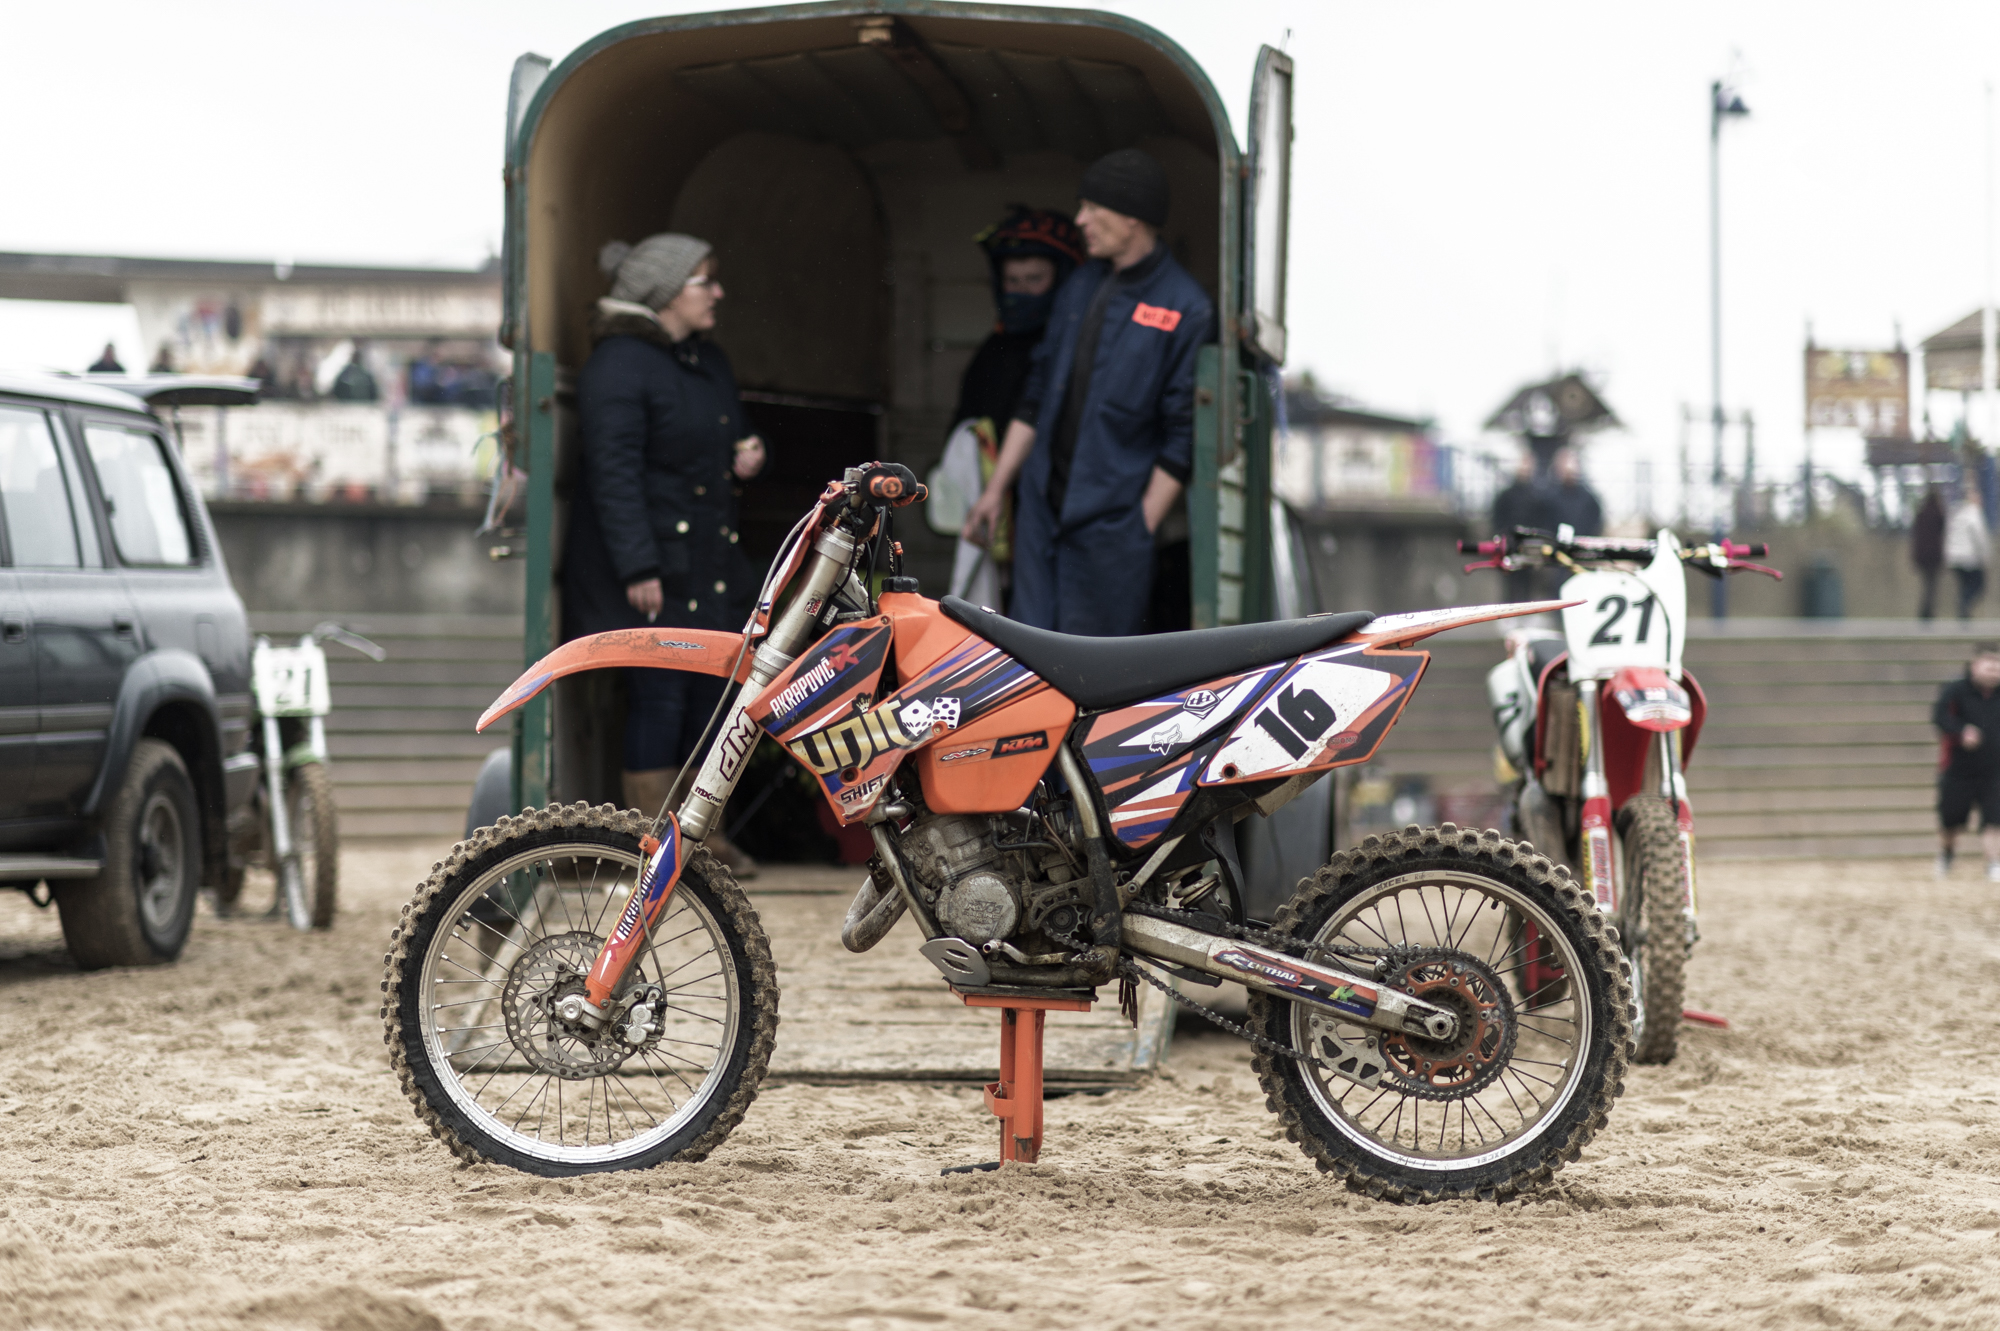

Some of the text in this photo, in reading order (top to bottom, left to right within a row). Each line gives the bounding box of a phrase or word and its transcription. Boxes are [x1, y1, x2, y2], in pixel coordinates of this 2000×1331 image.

[1588, 594, 1656, 646] 21
[1254, 682, 1336, 761] 16
[1000, 737, 1043, 753] KTM
[840, 772, 885, 804] SHIFT
[1376, 876, 1408, 892] EXCEL
[721, 943, 735, 975] EXCEL
[423, 1032, 438, 1064] EXCEL
